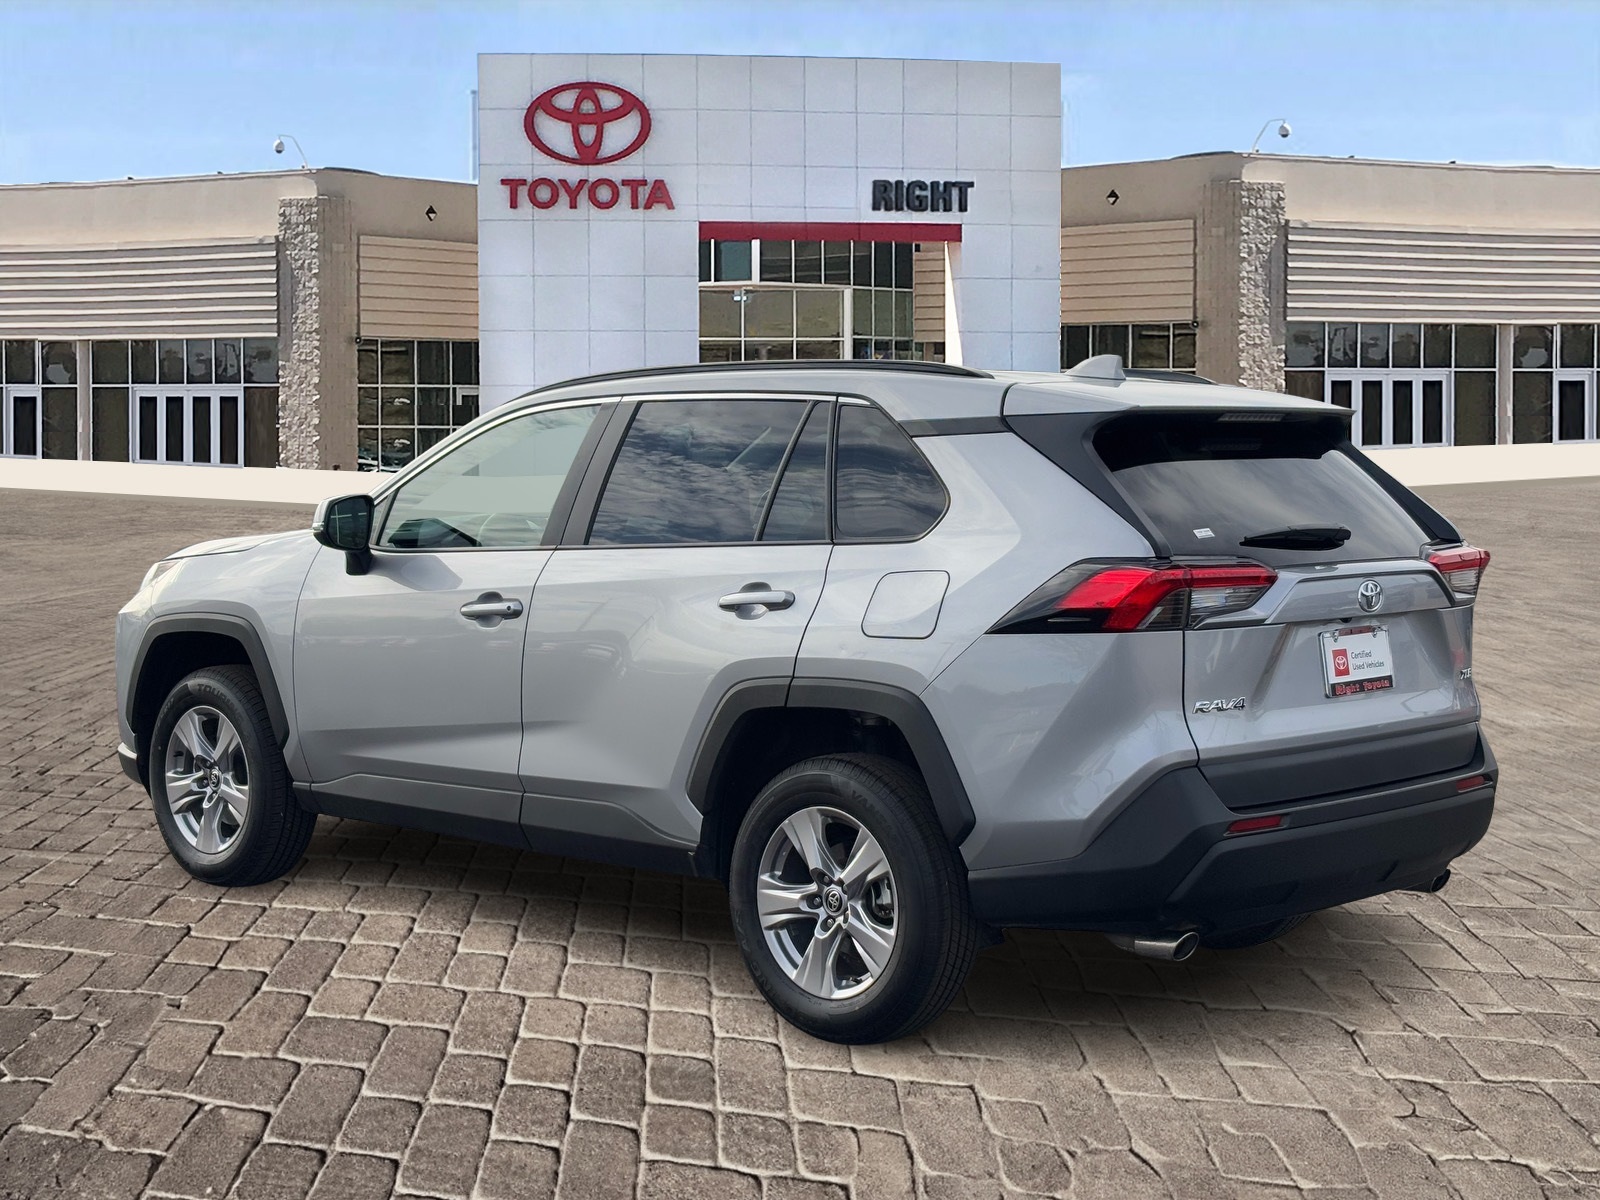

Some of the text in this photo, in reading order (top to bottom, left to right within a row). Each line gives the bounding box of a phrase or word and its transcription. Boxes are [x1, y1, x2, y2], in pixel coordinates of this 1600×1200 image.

[500, 177, 675, 210] TOYOTA
[872, 180, 974, 212] RIGHT
[1351, 651, 1372, 659] Certified
[1353, 661, 1384, 670] Used Vehicles
[1335, 679, 1390, 696] Right Toyota
[1192, 696, 1246, 714] RAV4
